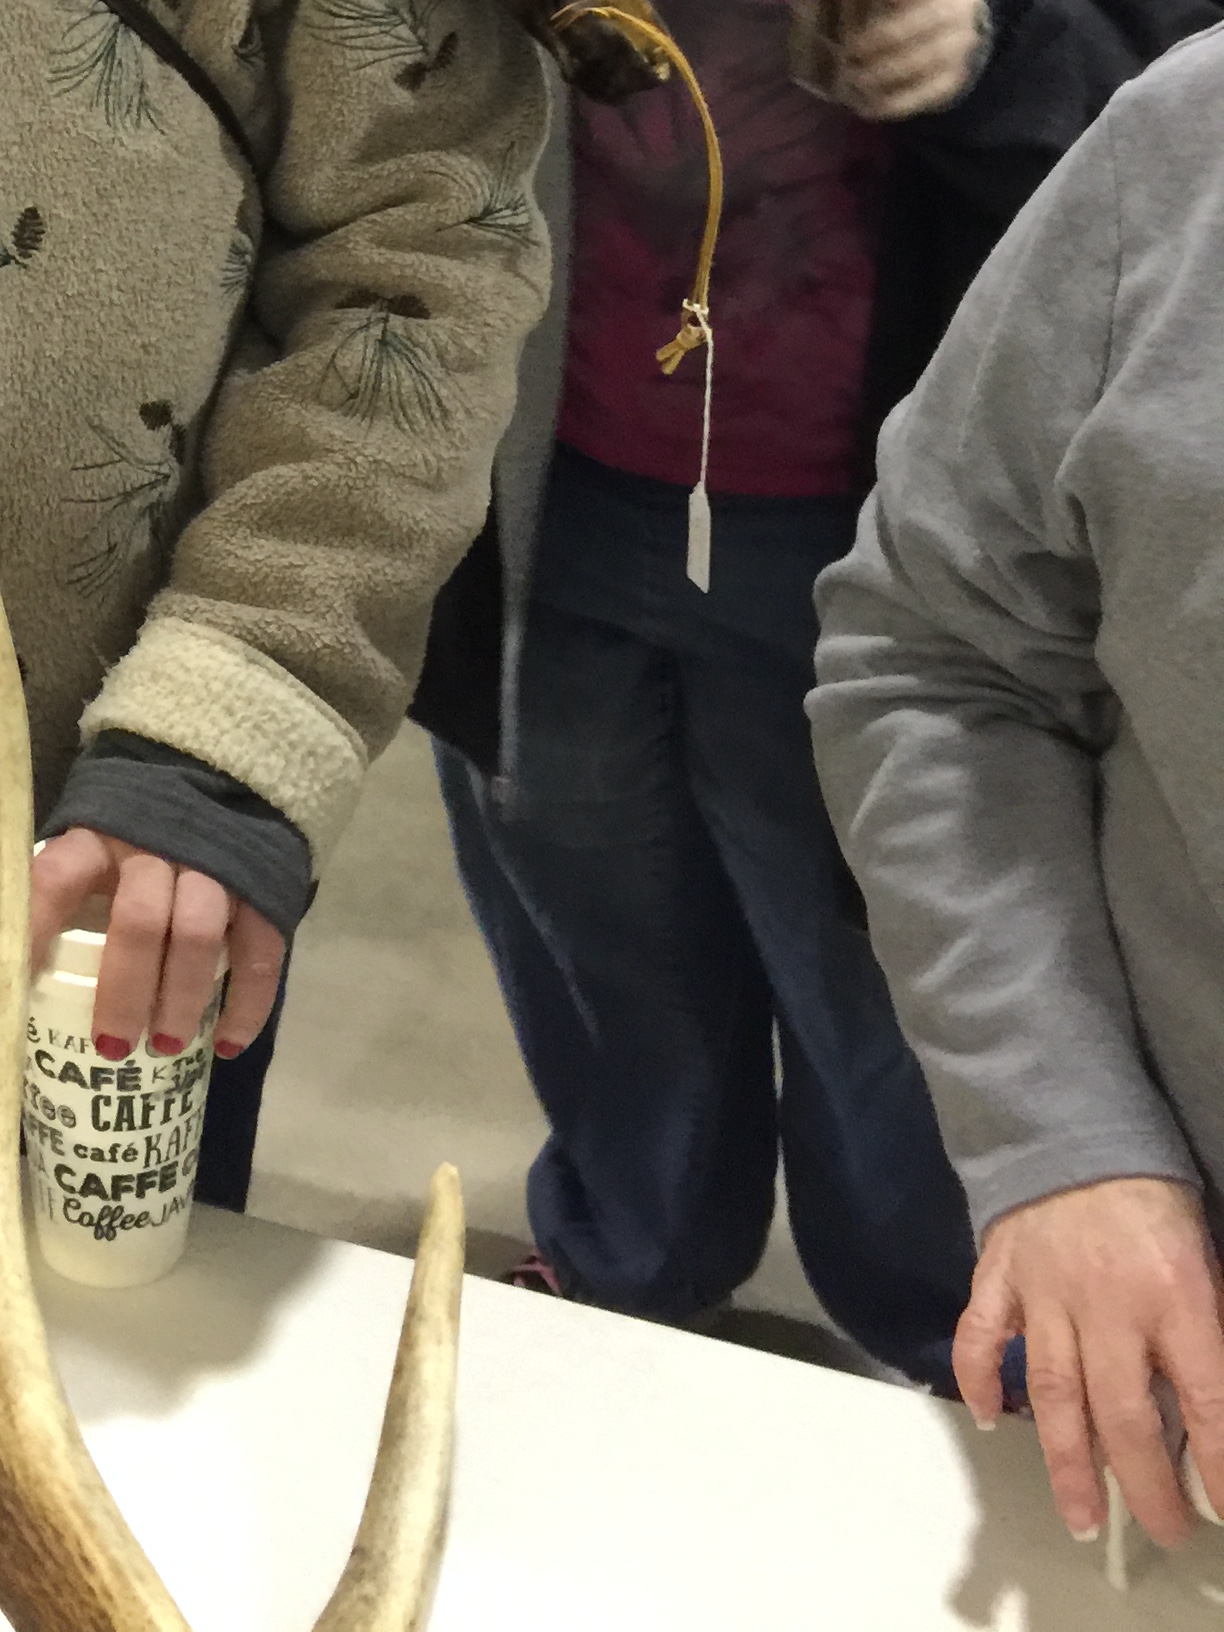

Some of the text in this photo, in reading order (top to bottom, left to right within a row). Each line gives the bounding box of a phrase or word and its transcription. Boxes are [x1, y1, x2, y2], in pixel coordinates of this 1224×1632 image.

[35, 1049, 142, 1092] CAFÉ
[73, 1142, 139, 1163] café
[54, 1162, 179, 1202] CAFFE
[62, 1196, 152, 1242] Coffee
